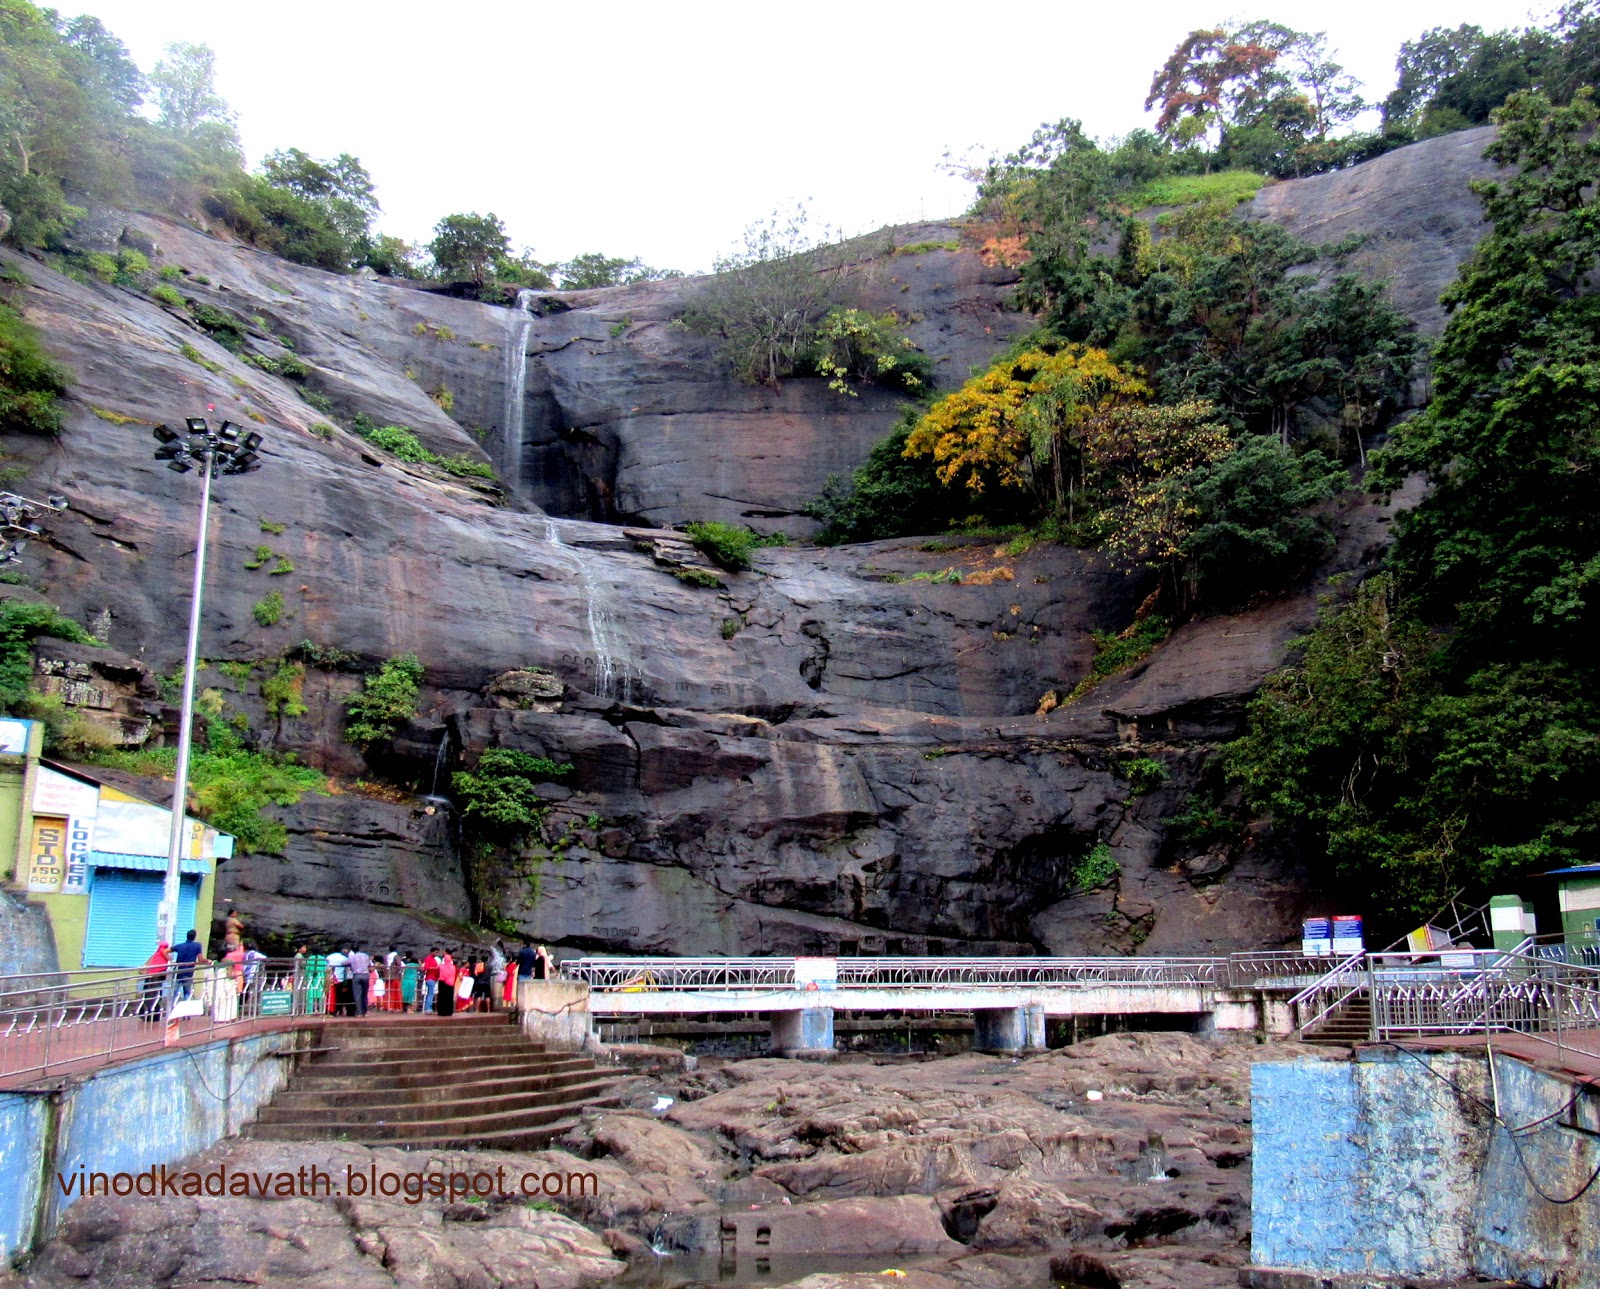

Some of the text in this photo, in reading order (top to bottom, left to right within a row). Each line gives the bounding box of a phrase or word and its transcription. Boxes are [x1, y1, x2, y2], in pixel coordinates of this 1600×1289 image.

[36, 828, 60, 865] STD
[67, 819, 89, 886] LOCKER
[31, 867, 60, 875] ISD
